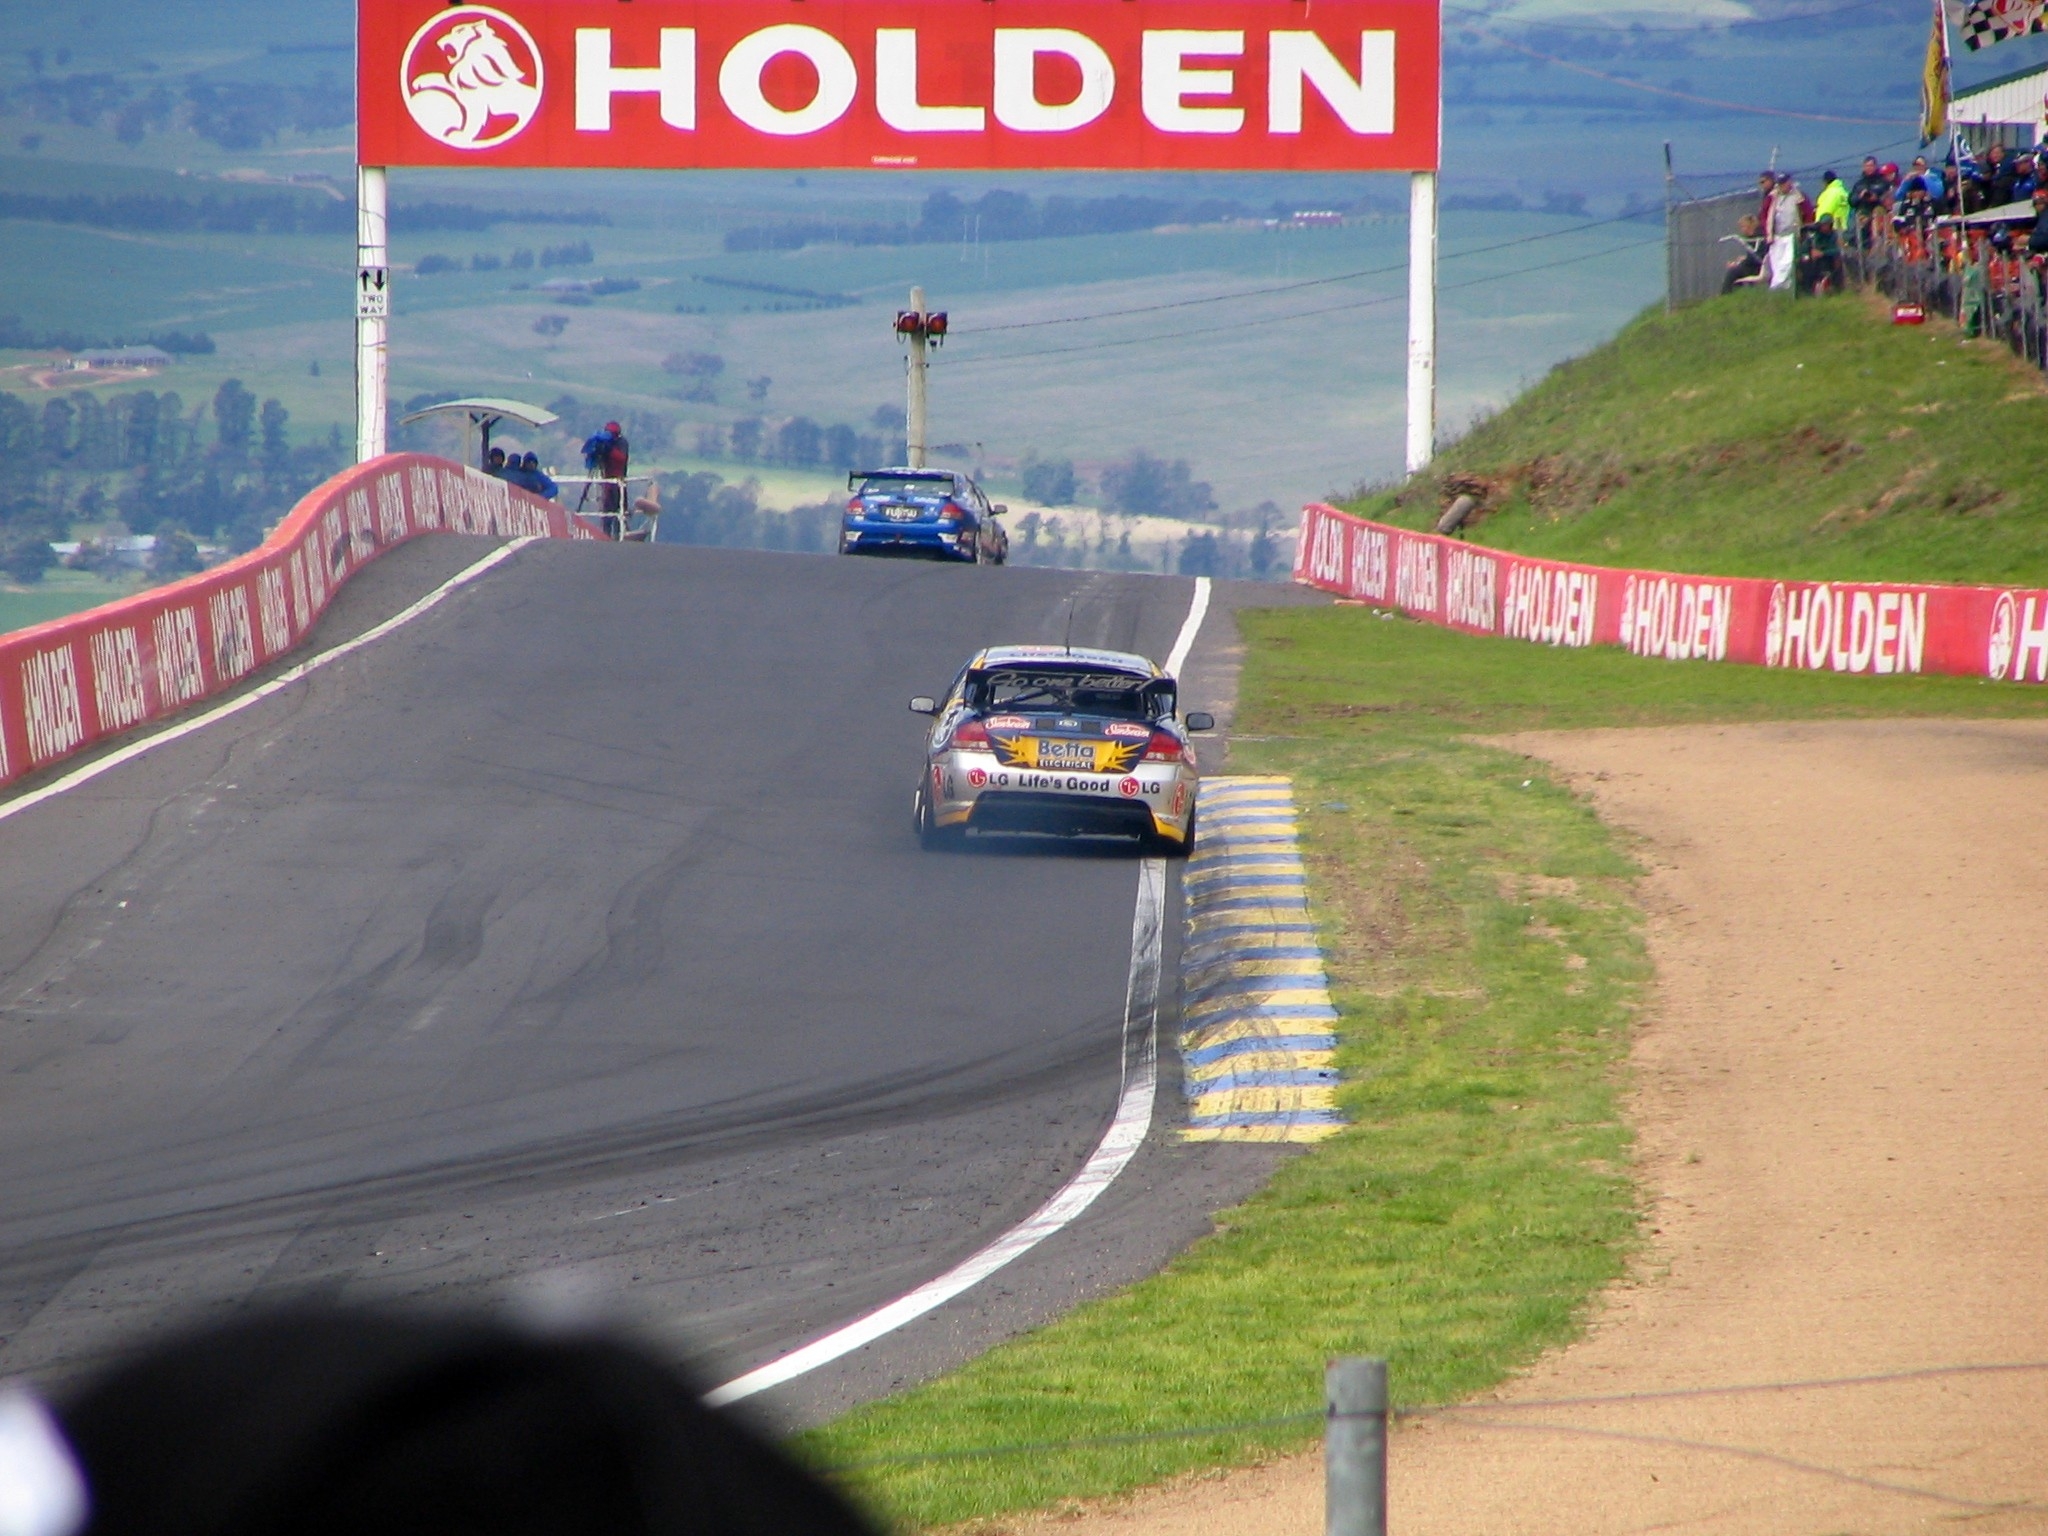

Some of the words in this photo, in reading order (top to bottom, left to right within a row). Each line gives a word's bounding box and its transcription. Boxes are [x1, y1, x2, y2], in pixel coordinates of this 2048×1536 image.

[574, 24, 1394, 135] HOLDEN
[360, 306, 384, 314] WAY
[361, 294, 383, 303] TWO
[1513, 565, 1598, 647] HOLDEN
[1633, 577, 1732, 661] HOLDEN
[1783, 584, 1927, 673] HOLDEN
[987, 671, 1027, 687] Go
[1032, 676, 1073, 687] one
[26, 643, 83, 759] HOLDEN
[1038, 741, 1094, 757] Betta
[1039, 760, 1093, 769] ELECTRICAL
[989, 771, 1008, 785] LG
[1019, 774, 1062, 788] Life's
[1066, 777, 1109, 792] Good
[1142, 782, 1160, 794] LG
